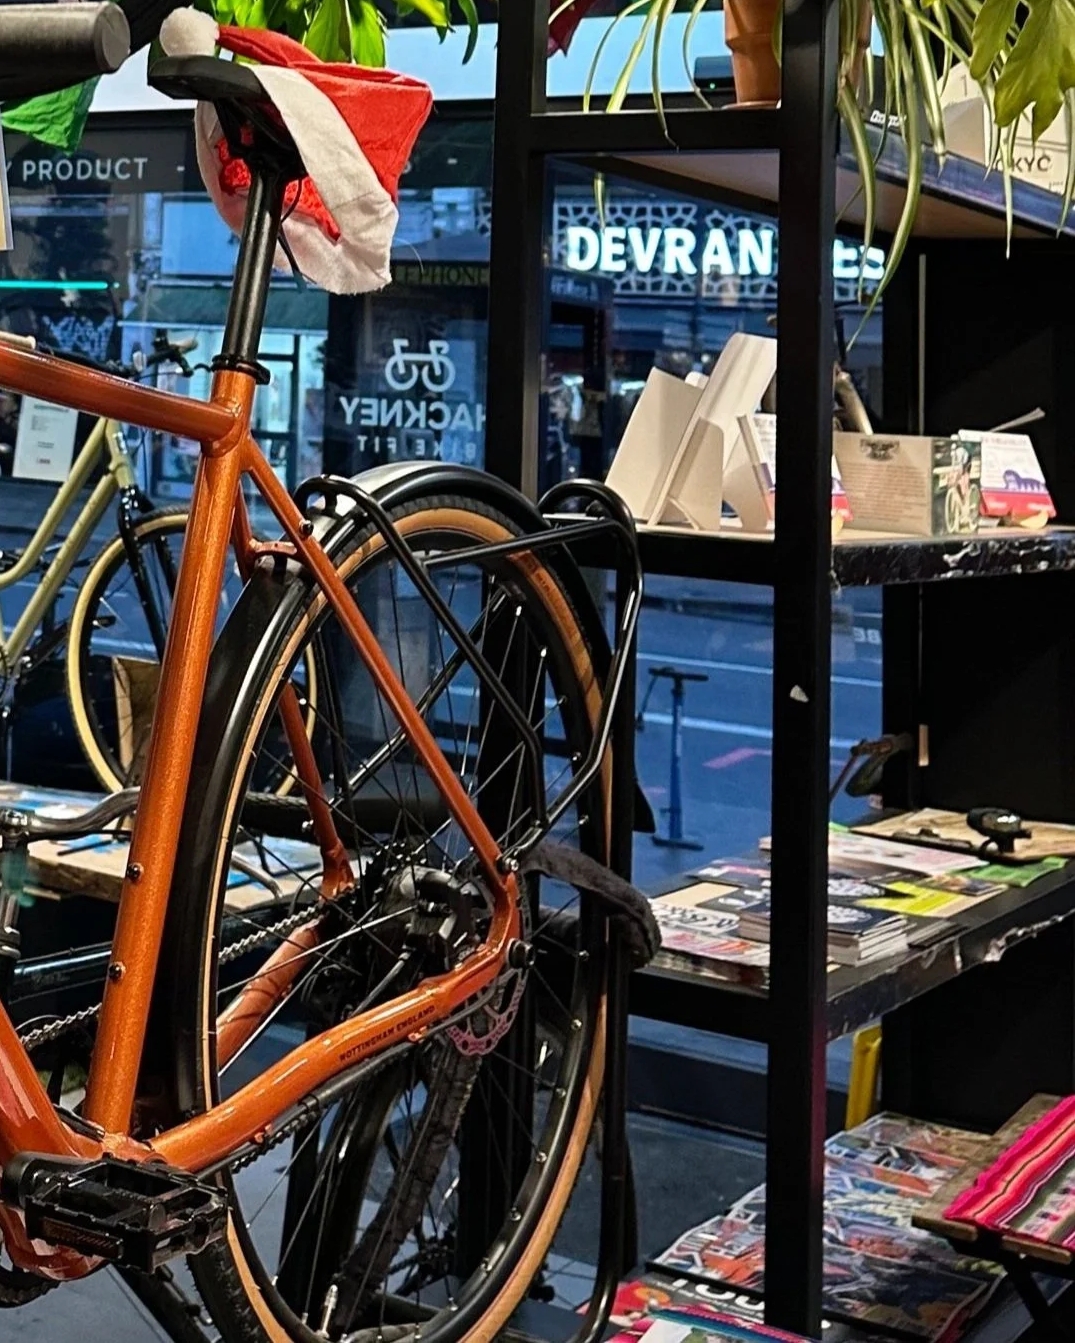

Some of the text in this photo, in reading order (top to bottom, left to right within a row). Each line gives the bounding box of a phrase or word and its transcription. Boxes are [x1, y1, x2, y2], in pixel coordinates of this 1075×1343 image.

[22, 157, 149, 182] PRODUCT
[566, 225, 774, 277] DEVRAN
[339, 1004, 436, 1062] NOTTINGHAM ENGLAND
